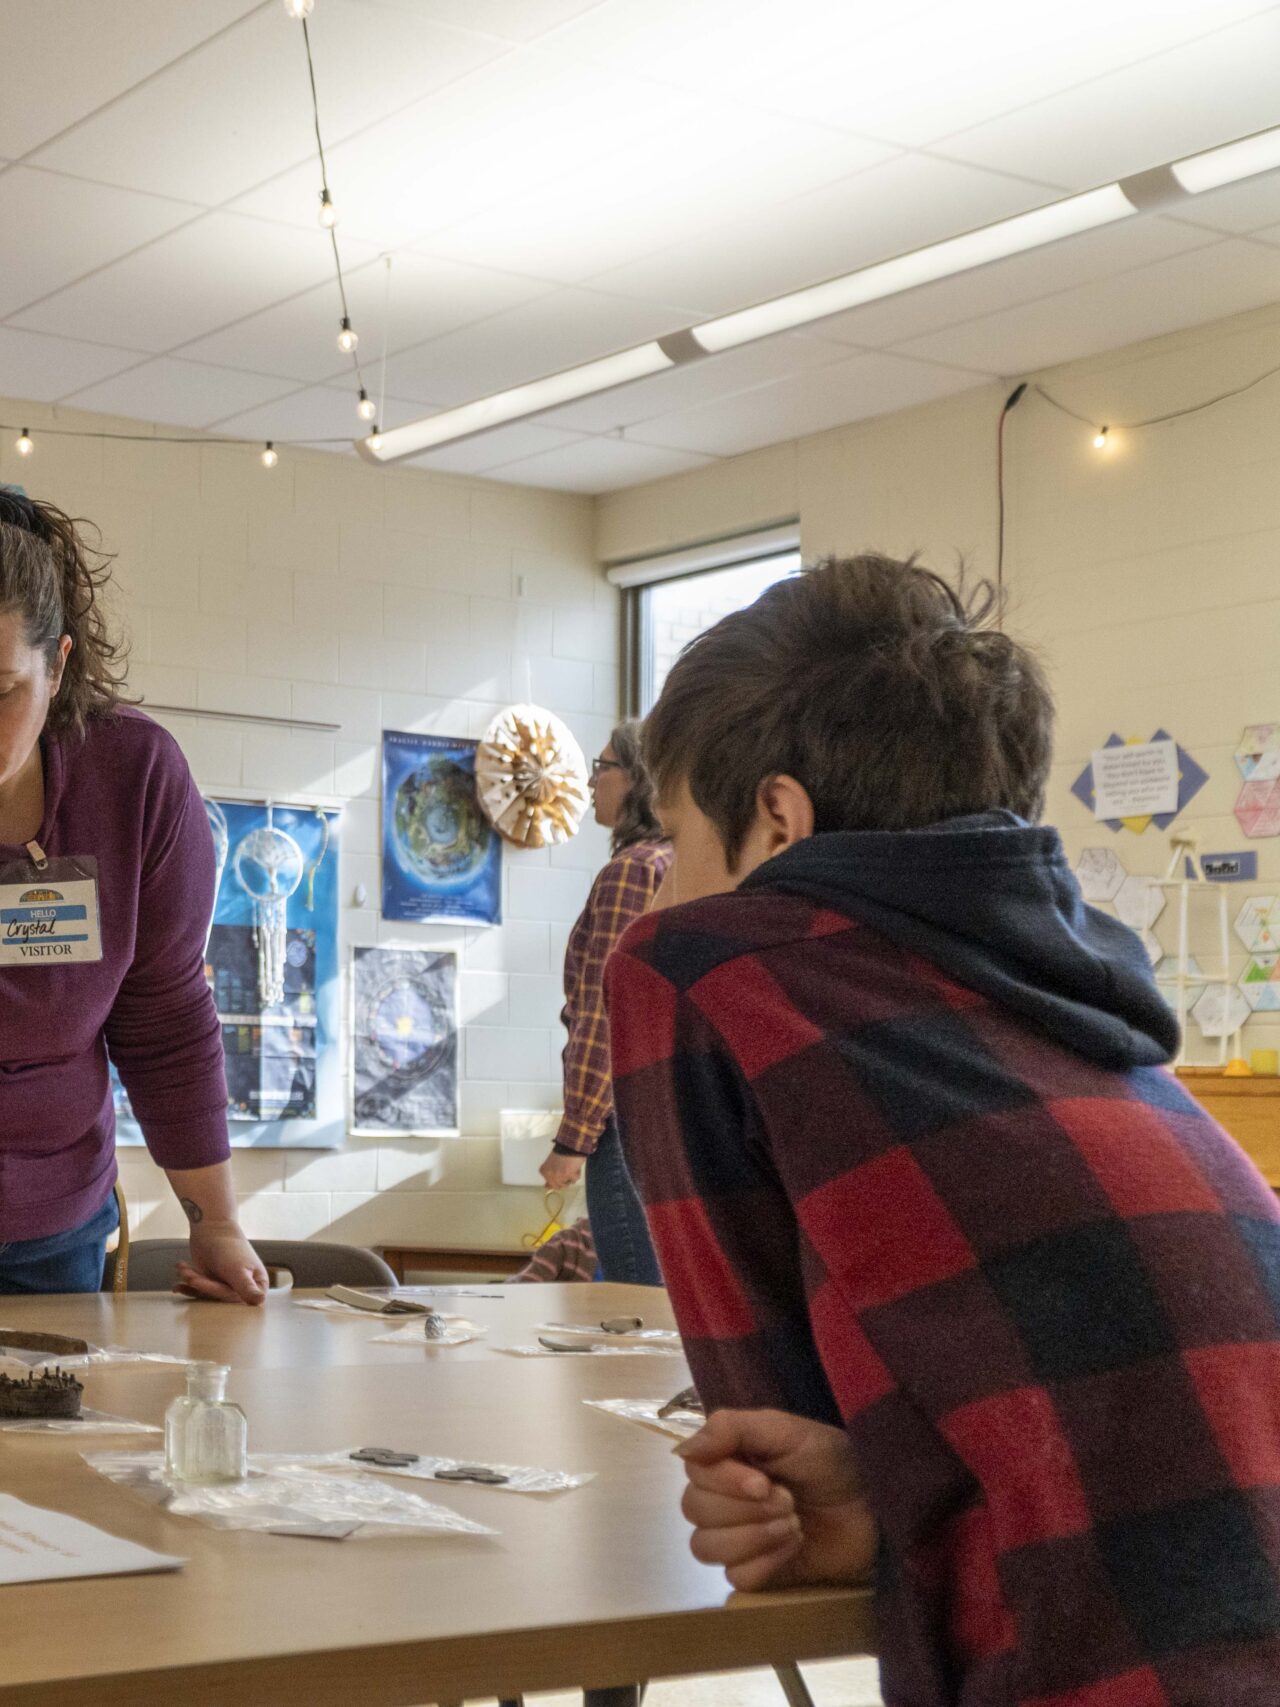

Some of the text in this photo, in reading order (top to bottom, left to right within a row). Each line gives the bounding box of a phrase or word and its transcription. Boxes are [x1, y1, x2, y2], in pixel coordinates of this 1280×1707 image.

[30, 909, 56, 918] HELLO
[7, 918, 57, 944] Crystal
[20, 944, 73, 957] VISITOR
